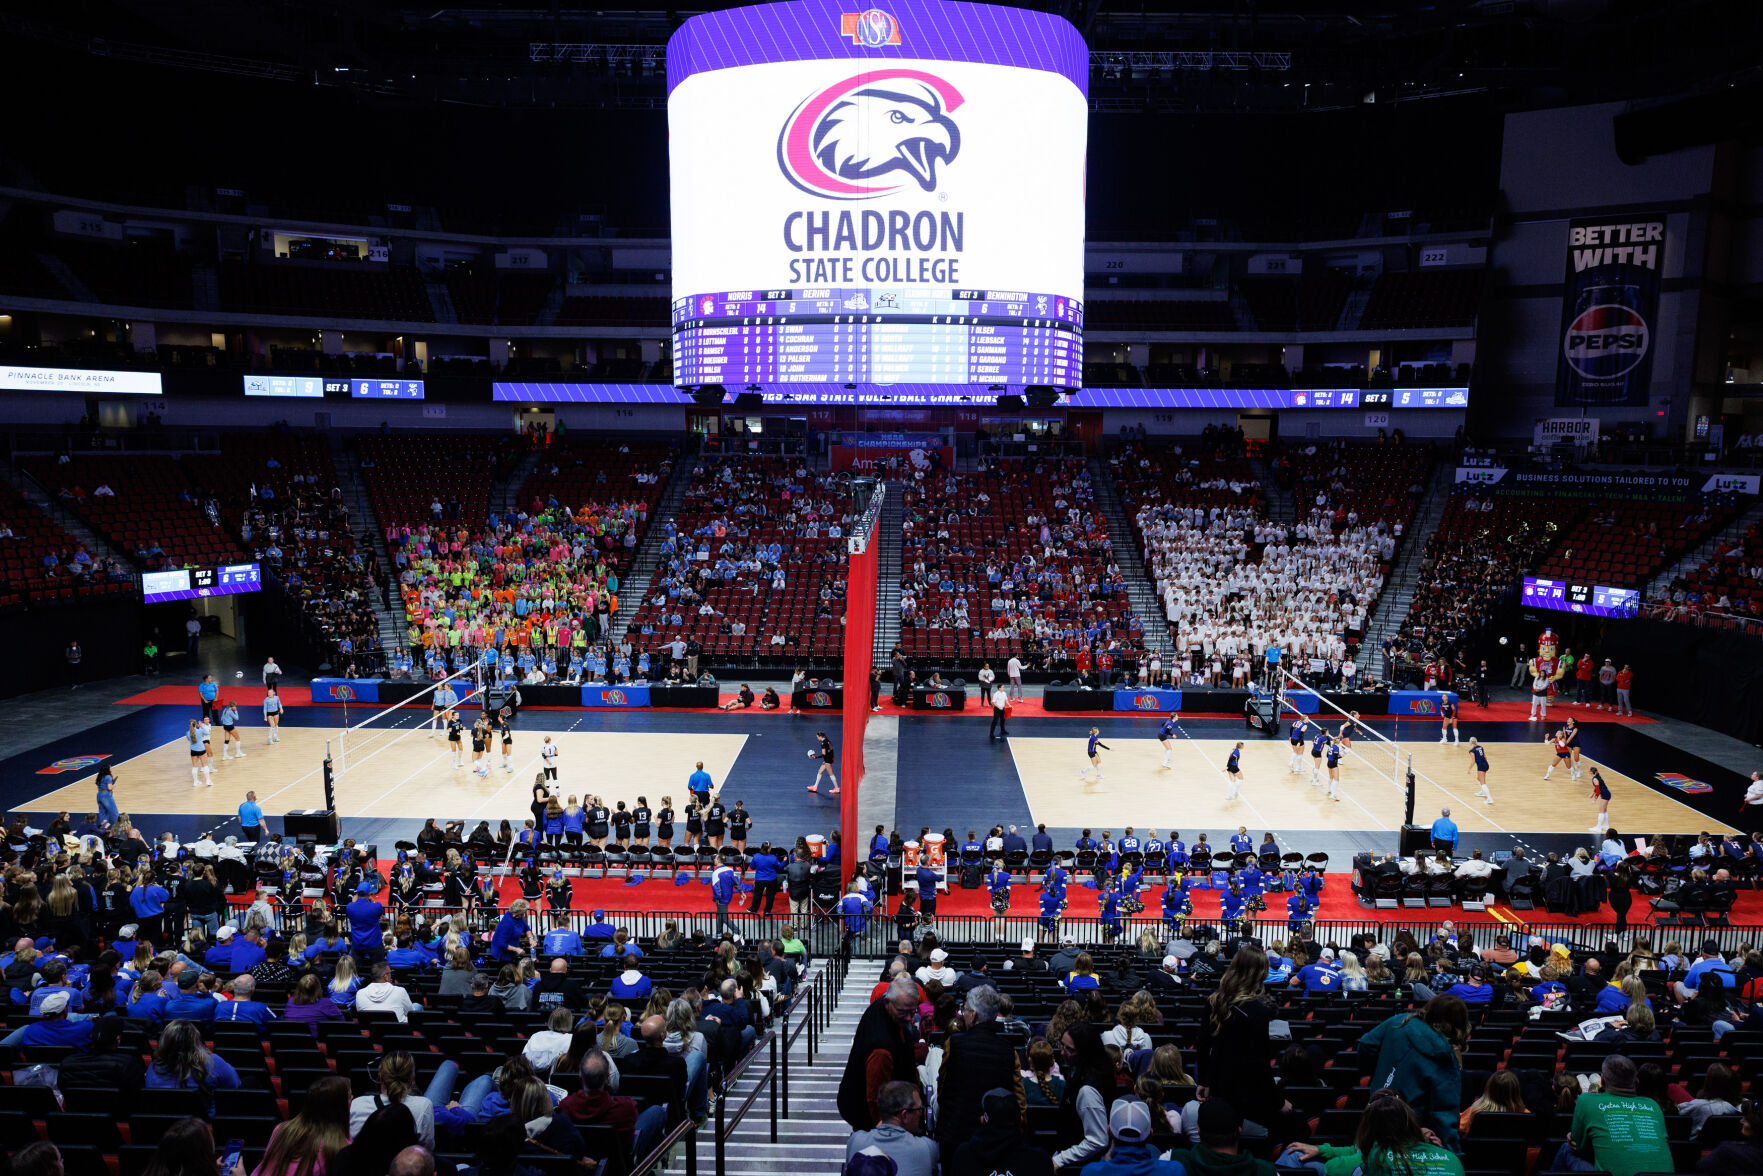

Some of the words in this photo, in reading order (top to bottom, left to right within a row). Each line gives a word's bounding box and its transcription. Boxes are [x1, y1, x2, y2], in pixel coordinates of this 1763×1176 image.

[783, 209, 963, 252] CHADRON
[1569, 222, 1664, 247] BETTER
[369, 248, 388, 258] 216
[1424, 253, 1445, 262] 222
[1573, 245, 1657, 273] WITH
[789, 258, 853, 283] STATE
[862, 257, 959, 283] COLLEGE
[728, 292, 752, 301] NORRIS
[768, 291, 779, 299] SET
[803, 289, 830, 298] GERING
[987, 291, 1028, 301] BENNINGTON
[757, 303, 766, 313] 14
[789, 302, 796, 312] 5
[981, 304, 988, 313] 6
[785, 335, 814, 343] COCHRAN
[1568, 332, 1645, 351] PEPSI
[785, 345, 818, 353] ANDERSON
[7, 371, 54, 380] PINNACLE
[58, 373, 82, 381] BANK
[86, 374, 115, 382] ARENA
[360, 383, 368, 394] 6
[1340, 393, 1354, 404] 14
[1401, 393, 1411, 404] 5
[143, 402, 165, 411] 114
[811, 411, 830, 420] 117
[959, 412, 977, 421] 118
[1367, 415, 1387, 423] 120
[1542, 422, 1590, 433] HARBOR
[1466, 471, 1494, 481] Lutz
[1516, 473, 1560, 483] BUSINESS
[1562, 474, 1612, 484] SOLUTIONS
[1615, 476, 1655, 485] TAILORED
[1657, 477, 1669, 486] TO
[1672, 478, 1690, 487] YOU
[1715, 478, 1747, 490] Lutz
[639, 812, 646, 820] 13
[1124, 839, 1137, 848] 28
[931, 846, 938, 854] G
[1598, 1101, 1621, 1111] Gretna
[1621, 1102, 1637, 1111] High
[1638, 1103, 1654, 1112] School
[1412, 1152, 1428, 1163] High
[1430, 1153, 1450, 1161] School
